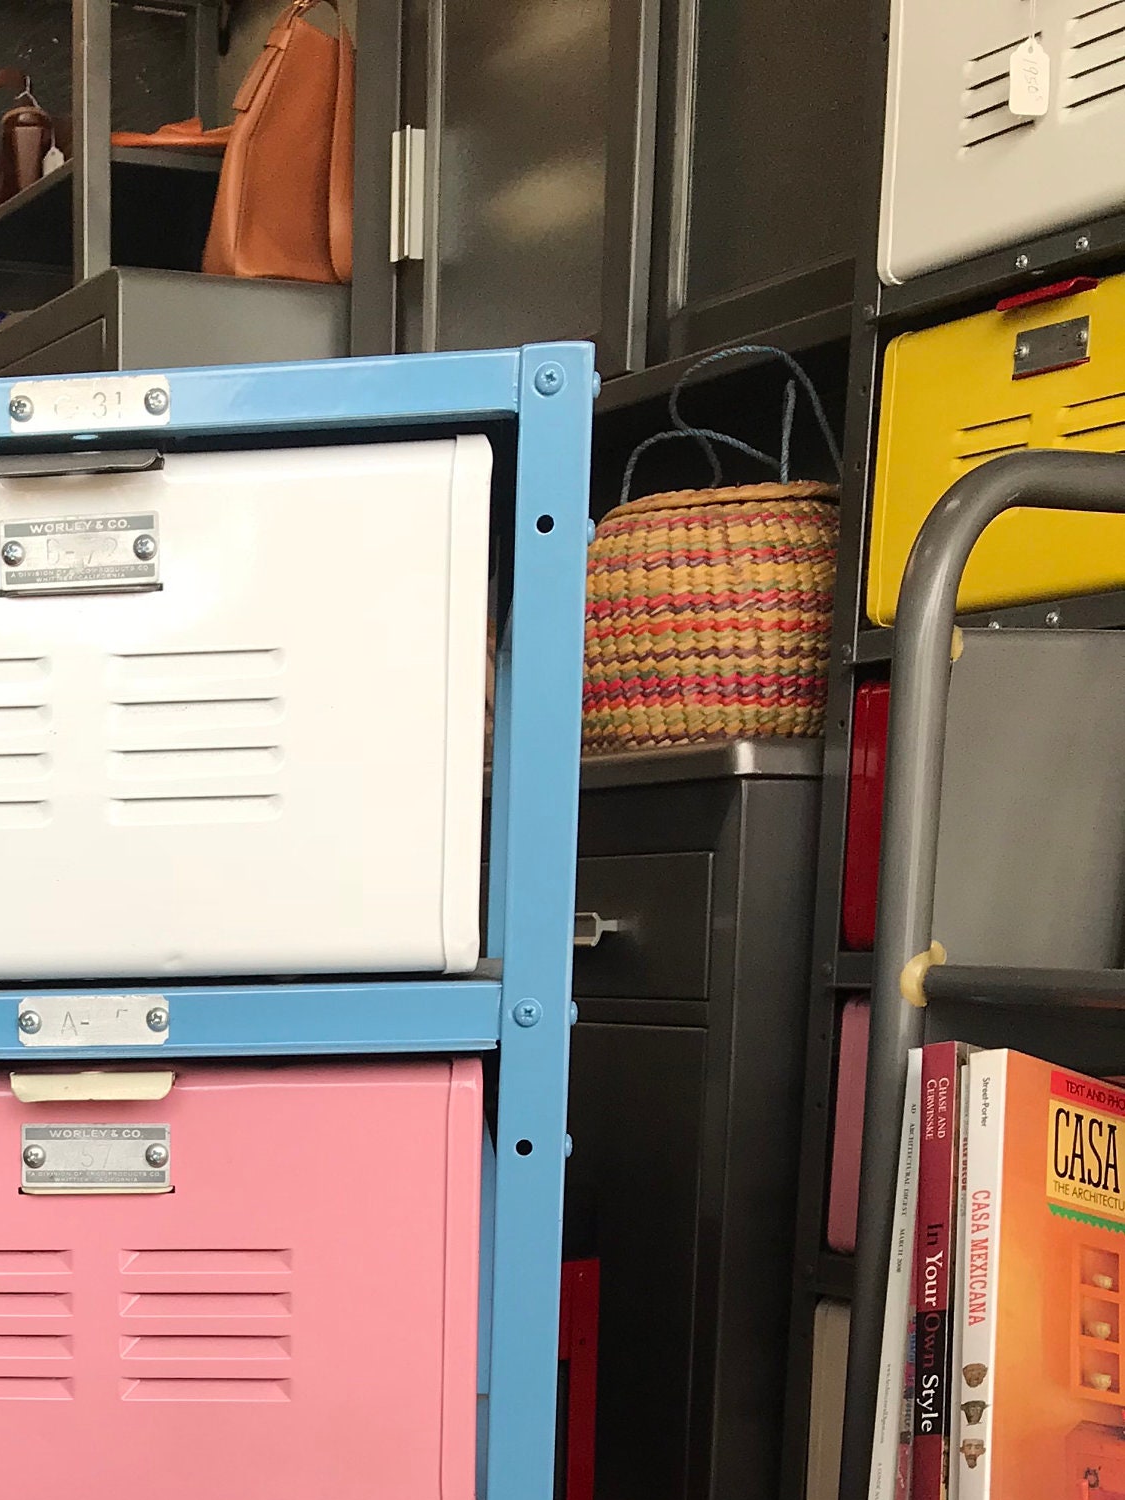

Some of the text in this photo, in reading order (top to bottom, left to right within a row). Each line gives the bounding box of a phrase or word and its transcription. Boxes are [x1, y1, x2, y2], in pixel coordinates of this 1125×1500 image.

[29, 518, 131, 534] WORLEY & CO.
[910, 1102, 917, 1115] AD
[925, 1078, 937, 1141] CERWINSKE
[937, 1077, 950, 1139] CHASE AND
[980, 1076, 991, 1128] Street-Porter
[1065, 1079, 1086, 1097] TEXT
[1086, 1087, 1106, 1104] AND
[48, 1128, 145, 1139] WORLEY & CO.
[1053, 1107, 1121, 1194] CASA
[1053, 1179, 1125, 1212] THE ARCHITECTU
[968, 1189, 992, 1327] CASA MEXICANA
[917, 1222, 944, 1434] In Your Own Style
